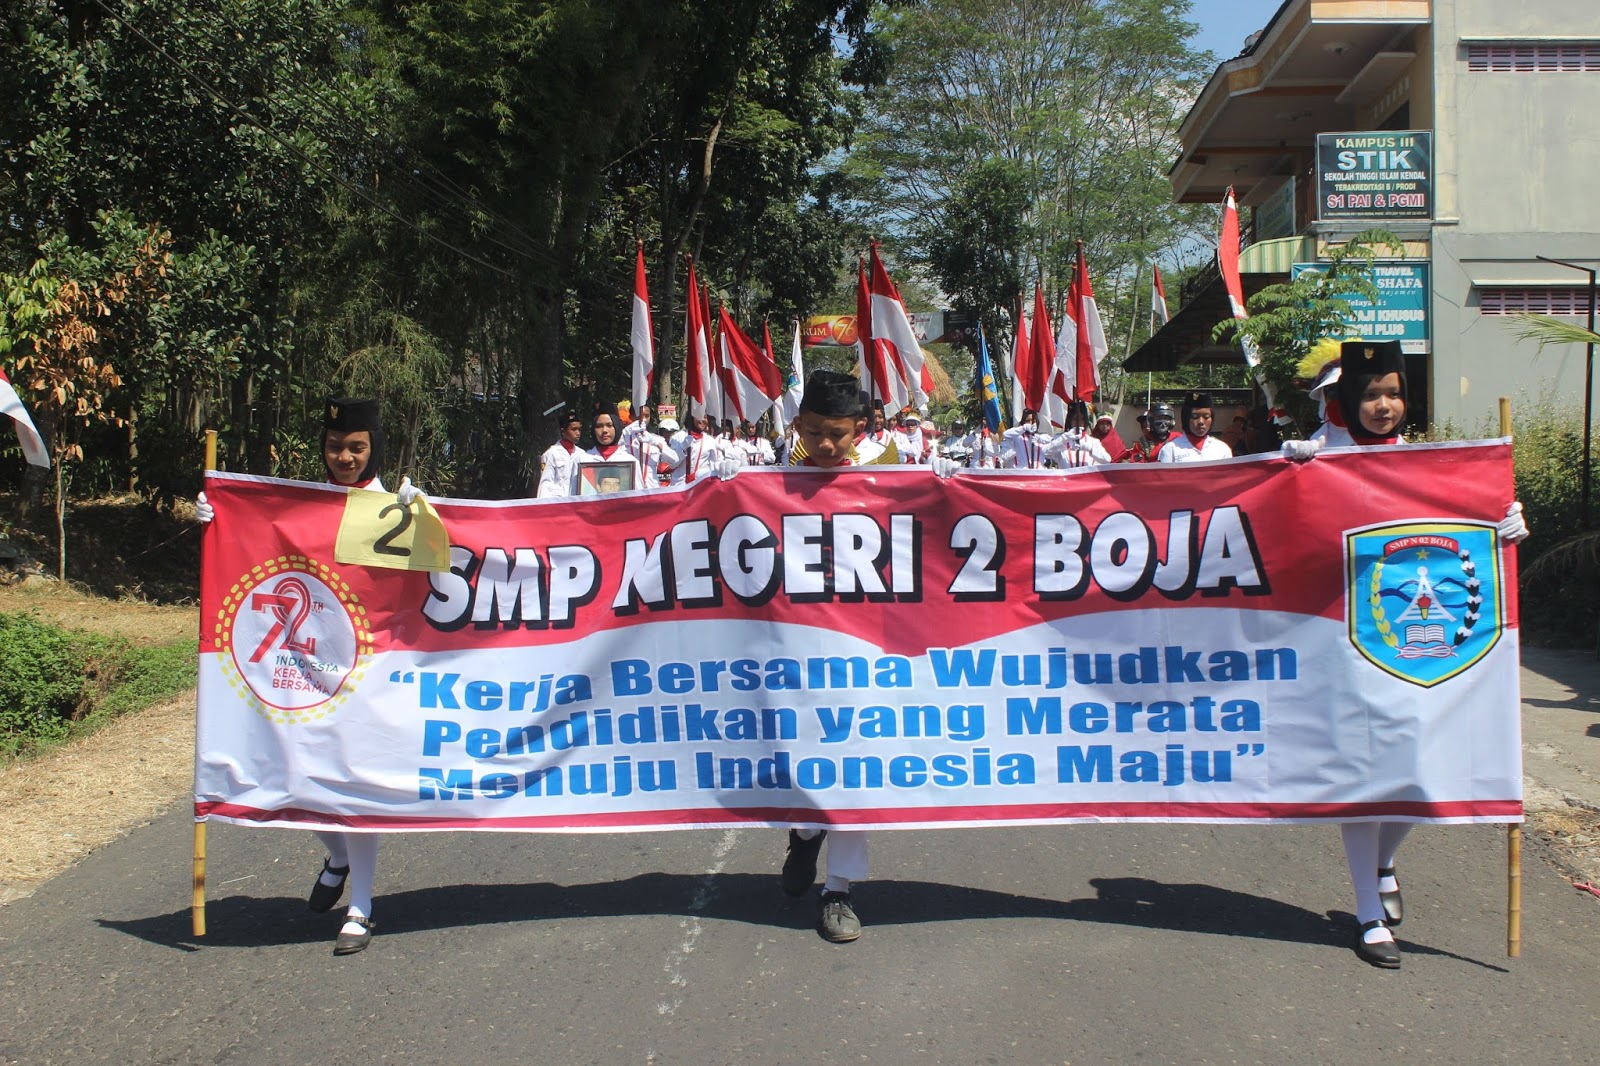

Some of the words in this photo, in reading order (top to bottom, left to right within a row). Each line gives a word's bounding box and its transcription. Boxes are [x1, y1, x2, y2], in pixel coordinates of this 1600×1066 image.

[1335, 137, 1396, 149] KAMPUS
[1400, 137, 1414, 148] III
[1337, 149, 1412, 171] STIK
[1324, 172, 1354, 181] SEKOLAH
[1355, 171, 1378, 181] TINGGI
[1379, 171, 1399, 180] ISLAM
[1400, 171, 1426, 180] KENDAL
[1335, 183, 1384, 191] TERAKREDITASI
[1327, 194, 1344, 208] S1
[1348, 194, 1371, 207] PAI
[1375, 194, 1386, 207] &
[1389, 193, 1425, 207] PGMI
[1374, 266, 1414, 276] TRAVEL
[1376, 278, 1423, 288] SHAFA
[1378, 309, 1425, 321] KHUSUS
[836, 316, 857, 342] 76
[1374, 323, 1405, 336] PLUS
[373, 503, 412, 556] 2
[1389, 539, 1409, 551] SMP
[1410, 537, 1418, 545] N
[1430, 537, 1453, 549] BOJA
[421, 544, 602, 631] SMP
[611, 512, 923, 616] NEGERI
[947, 513, 1006, 602] 2
[1033, 505, 1272, 602] BOJA
[249, 576, 317, 663] 72
[312, 601, 324, 611] TH
[273, 667, 313, 682] KERJA
[610, 654, 913, 698] Bersama
[926, 646, 1298, 691] Wujudkan
[272, 678, 331, 695] BERSAMA
[421, 703, 798, 759] Pendidikan
[815, 704, 986, 743] yang
[1006, 696, 1262, 735] Merata
[418, 754, 677, 801] Menuju
[695, 747, 1036, 790] Indonesia
